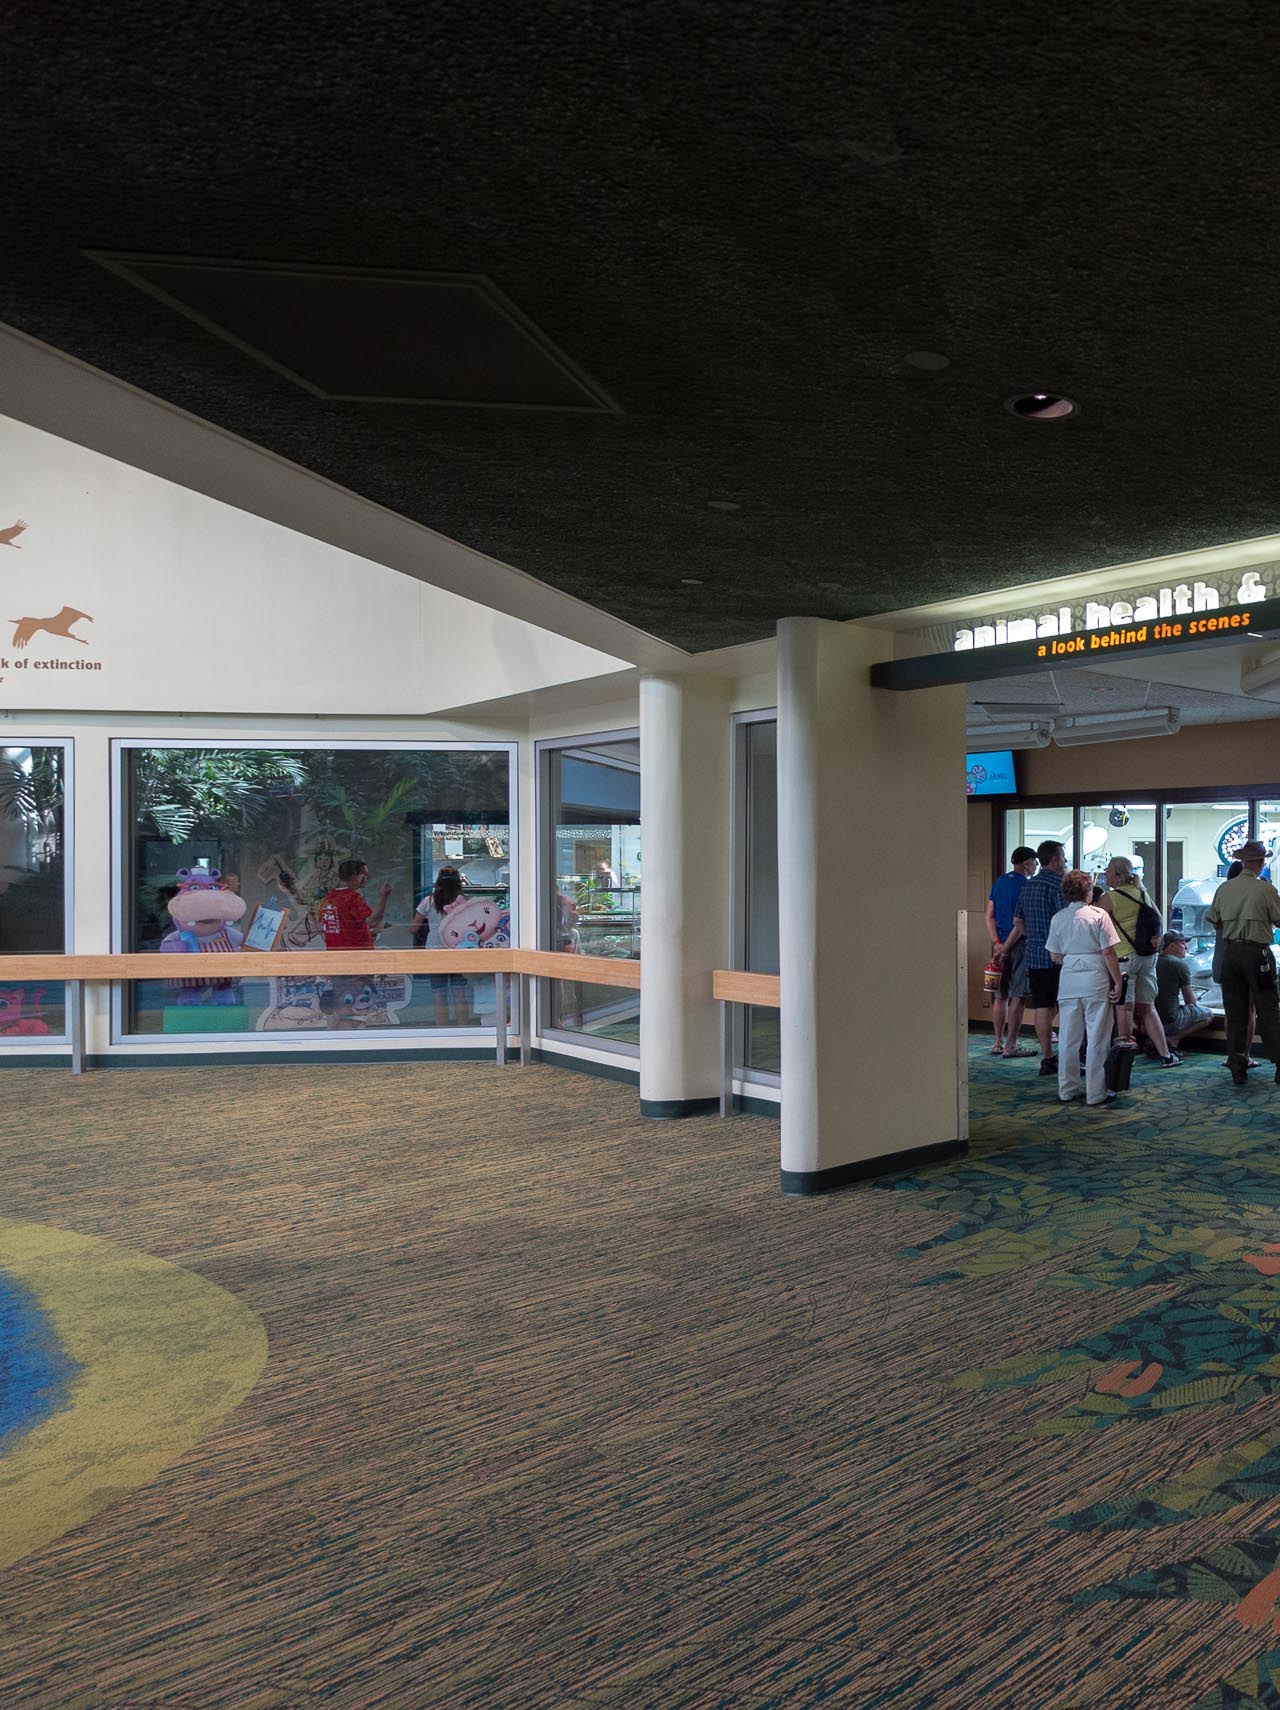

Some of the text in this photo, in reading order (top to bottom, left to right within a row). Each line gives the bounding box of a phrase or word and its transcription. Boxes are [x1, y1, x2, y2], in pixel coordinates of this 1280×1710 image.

[954, 606, 1072, 652] animal
[1085, 581, 1220, 632] health
[1236, 571, 1266, 605] &
[1037, 612, 1250, 657] a look behind the scenes
[14, 658, 29, 669] of
[33, 659, 102, 671] extinction
